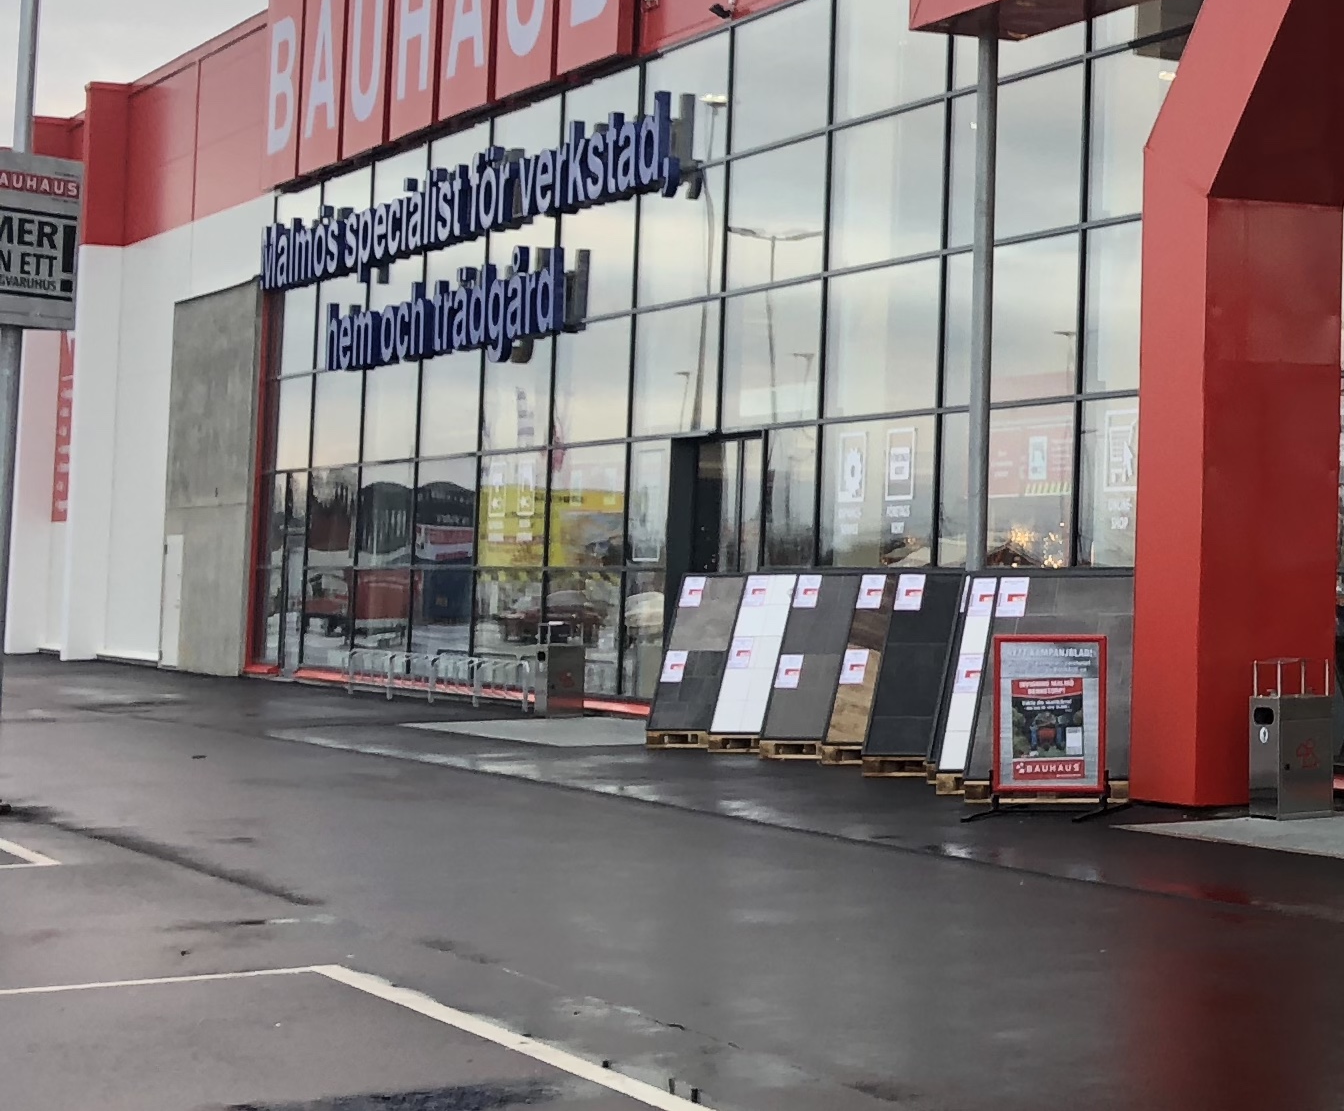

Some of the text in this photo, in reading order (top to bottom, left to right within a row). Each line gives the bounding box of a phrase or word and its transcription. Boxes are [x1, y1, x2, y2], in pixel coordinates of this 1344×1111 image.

[260, 91, 679, 290] Malmös specialist för verkstad,
[20, 252, 58, 278] ETT
[326, 247, 560, 370] hem och trädgård
[1026, 762, 1081, 774] BAUHAUS
